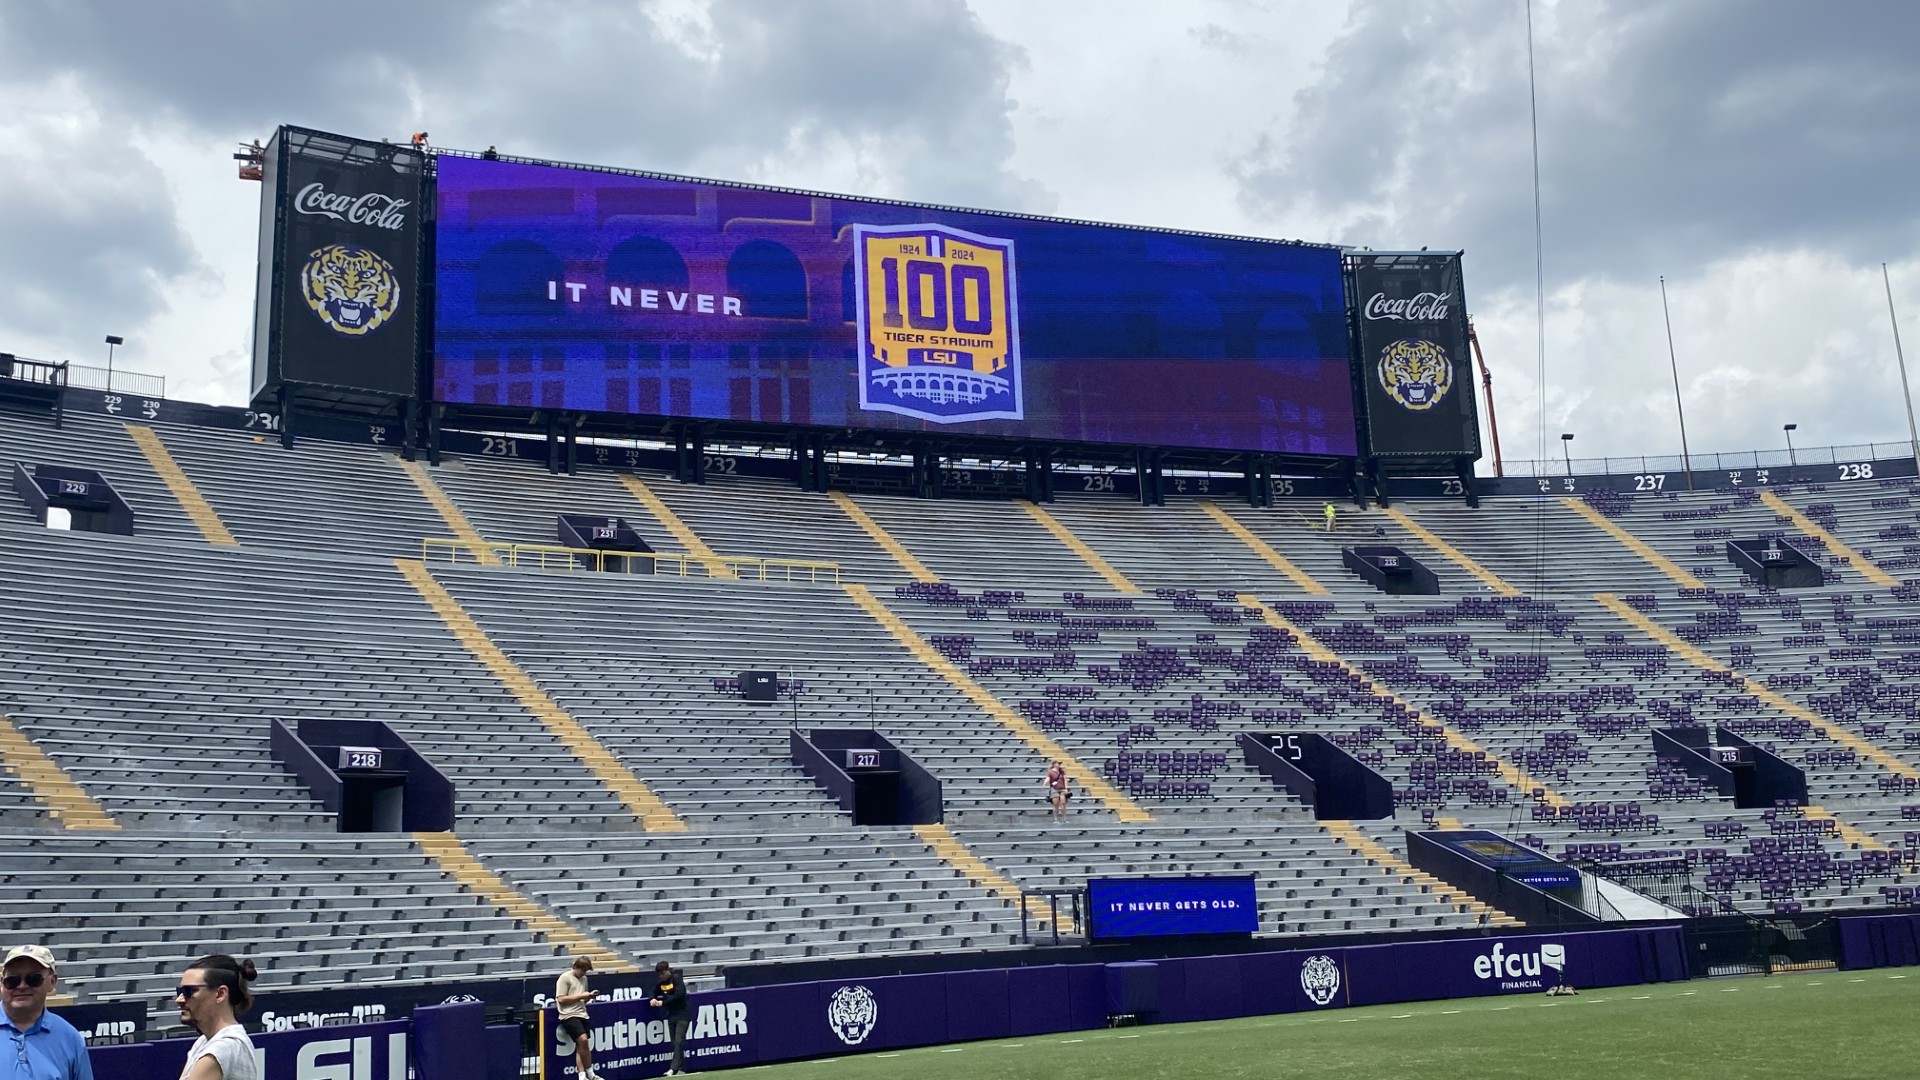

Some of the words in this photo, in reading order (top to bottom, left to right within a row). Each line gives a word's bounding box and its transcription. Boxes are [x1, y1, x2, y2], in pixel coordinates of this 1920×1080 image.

[294, 183, 411, 230] Coca-Cola
[900, 243, 920, 255] 1924
[952, 249, 974, 261] 2024
[548, 280, 587, 303] IT
[610, 286, 743, 316] NEVER
[881, 257, 993, 335] 100
[1364, 292, 1451, 320] Coca-Cola
[883, 332, 925, 344] TIGER
[930, 335, 994, 349] STADIUM
[923, 350, 957, 365] LSU
[104, 394, 122, 404] 229
[143, 400, 160, 409] 230
[370, 425, 386, 434] 230
[481, 437, 519, 457] 231
[625, 450, 639, 458] 232
[702, 456, 737, 475] 232
[1838, 463, 1874, 481] 238
[66, 483, 85, 493] 229
[1083, 475, 1115, 492] 234
[1270, 480, 1294, 495] 35
[1441, 480, 1469, 495] 23
[1633, 475, 1666, 492] 237
[600, 529, 614, 538] 231
[1767, 552, 1781, 560] 237
[1271, 735, 1302, 760] 25
[351, 754, 376, 767] 218
[857, 754, 875, 766] 217
[1722, 751, 1737, 762] 215
[1110, 903, 1123, 912] IT
[1129, 901, 1170, 911] NEVER
[1175, 900, 1207, 910] GETS
[1473, 942, 1542, 979] efcu
[1501, 979, 1542, 989] FINANCIAL
[607, 1056, 642, 1069] HEATING
[697, 1044, 742, 1057] ELECTRICAL
